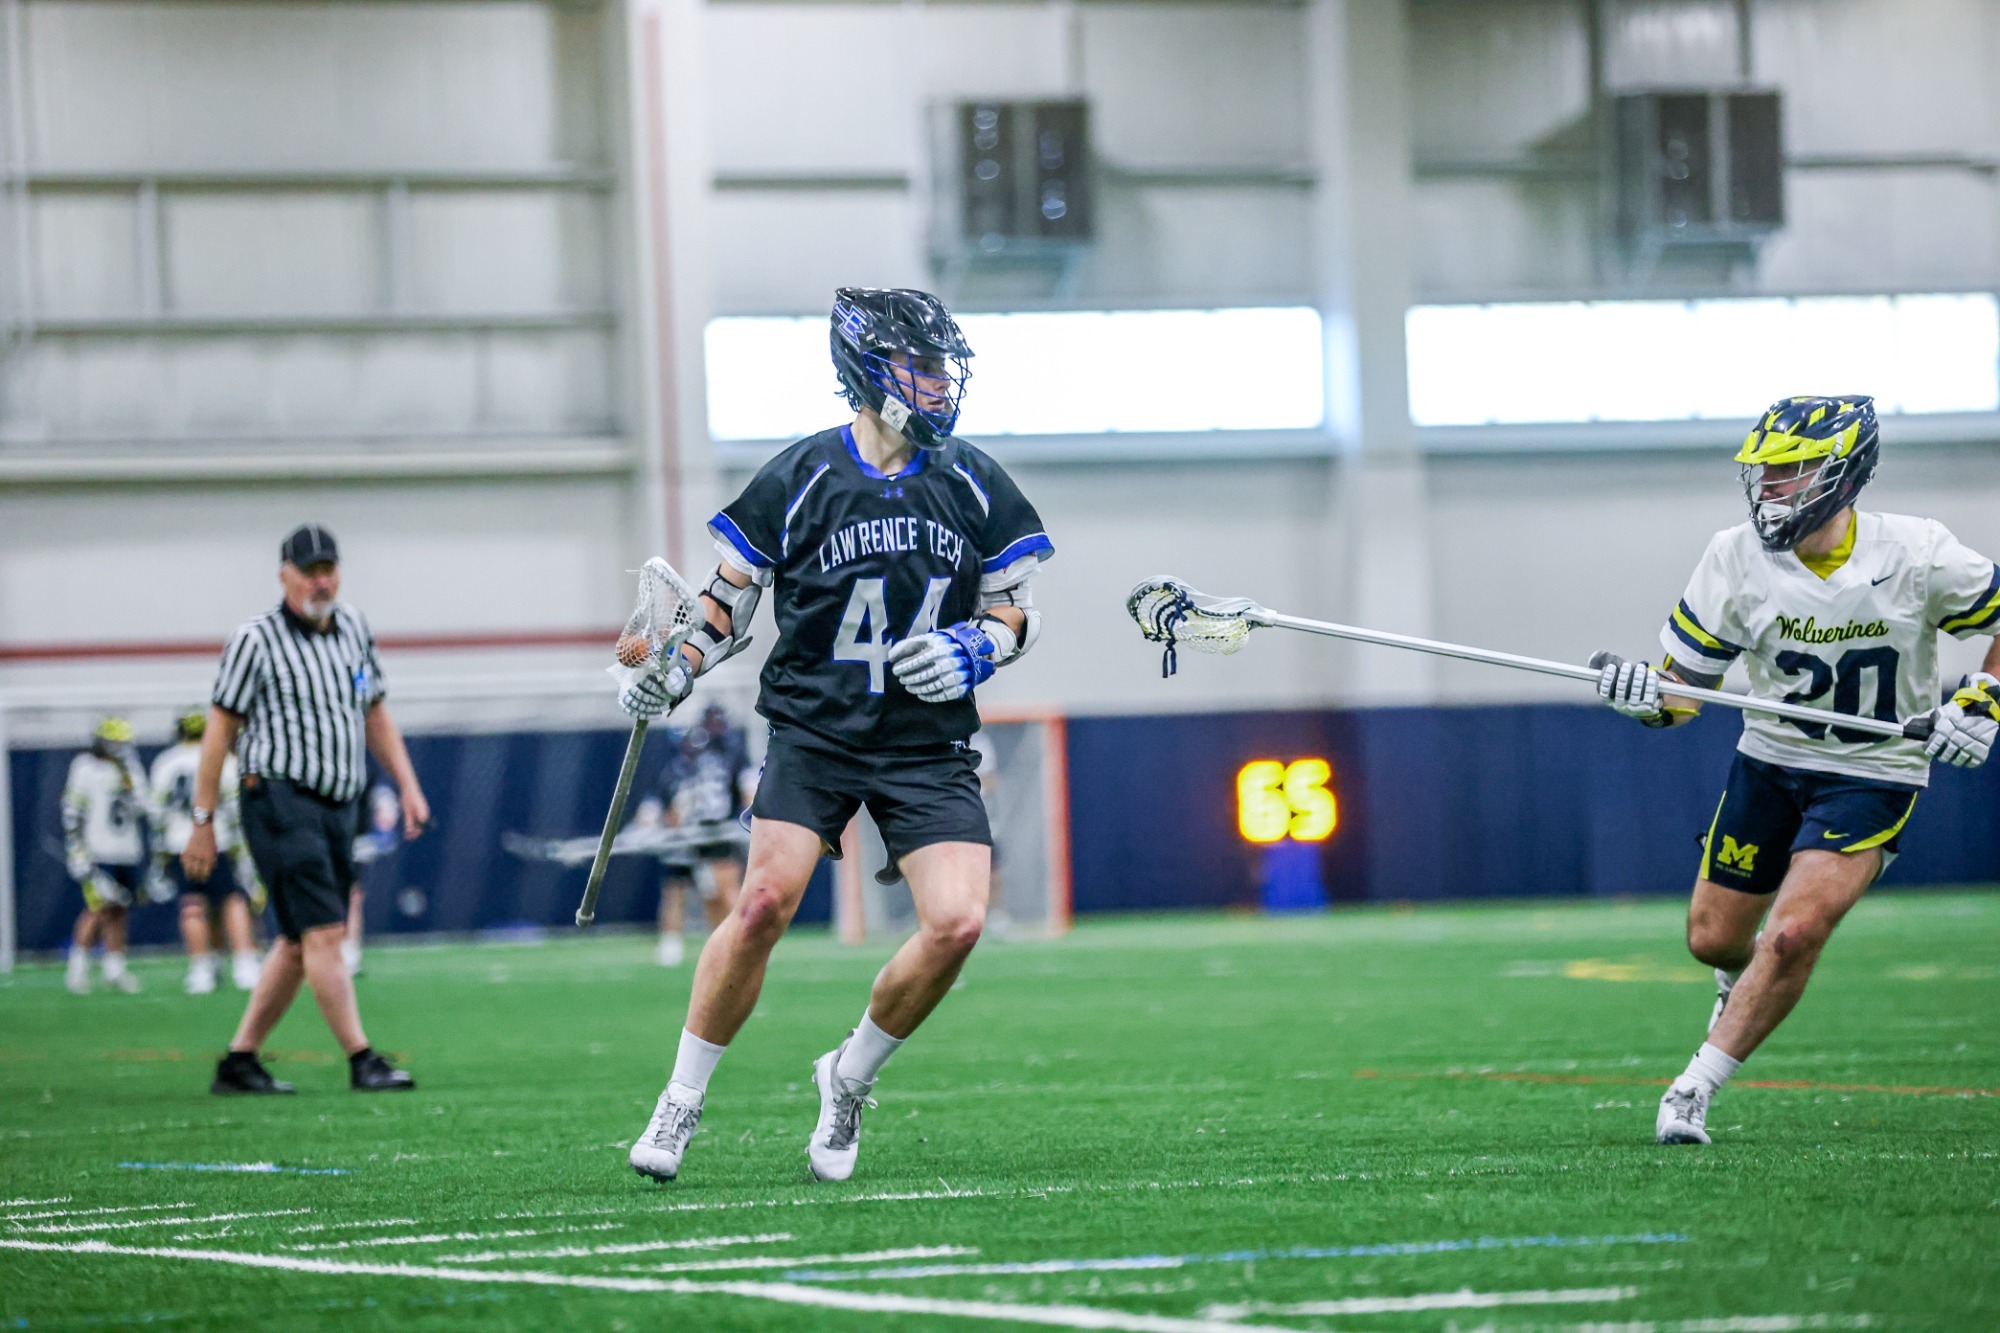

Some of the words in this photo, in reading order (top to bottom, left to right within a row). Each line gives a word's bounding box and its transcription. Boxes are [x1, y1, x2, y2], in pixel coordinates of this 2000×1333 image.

[818, 517, 918, 574] LAWRENCE
[926, 519, 965, 572] TECH
[1775, 615, 1889, 645] Wolverines
[1774, 645, 1900, 744] 20
[1237, 757, 1337, 843] 65
[1716, 834, 1759, 871] M
